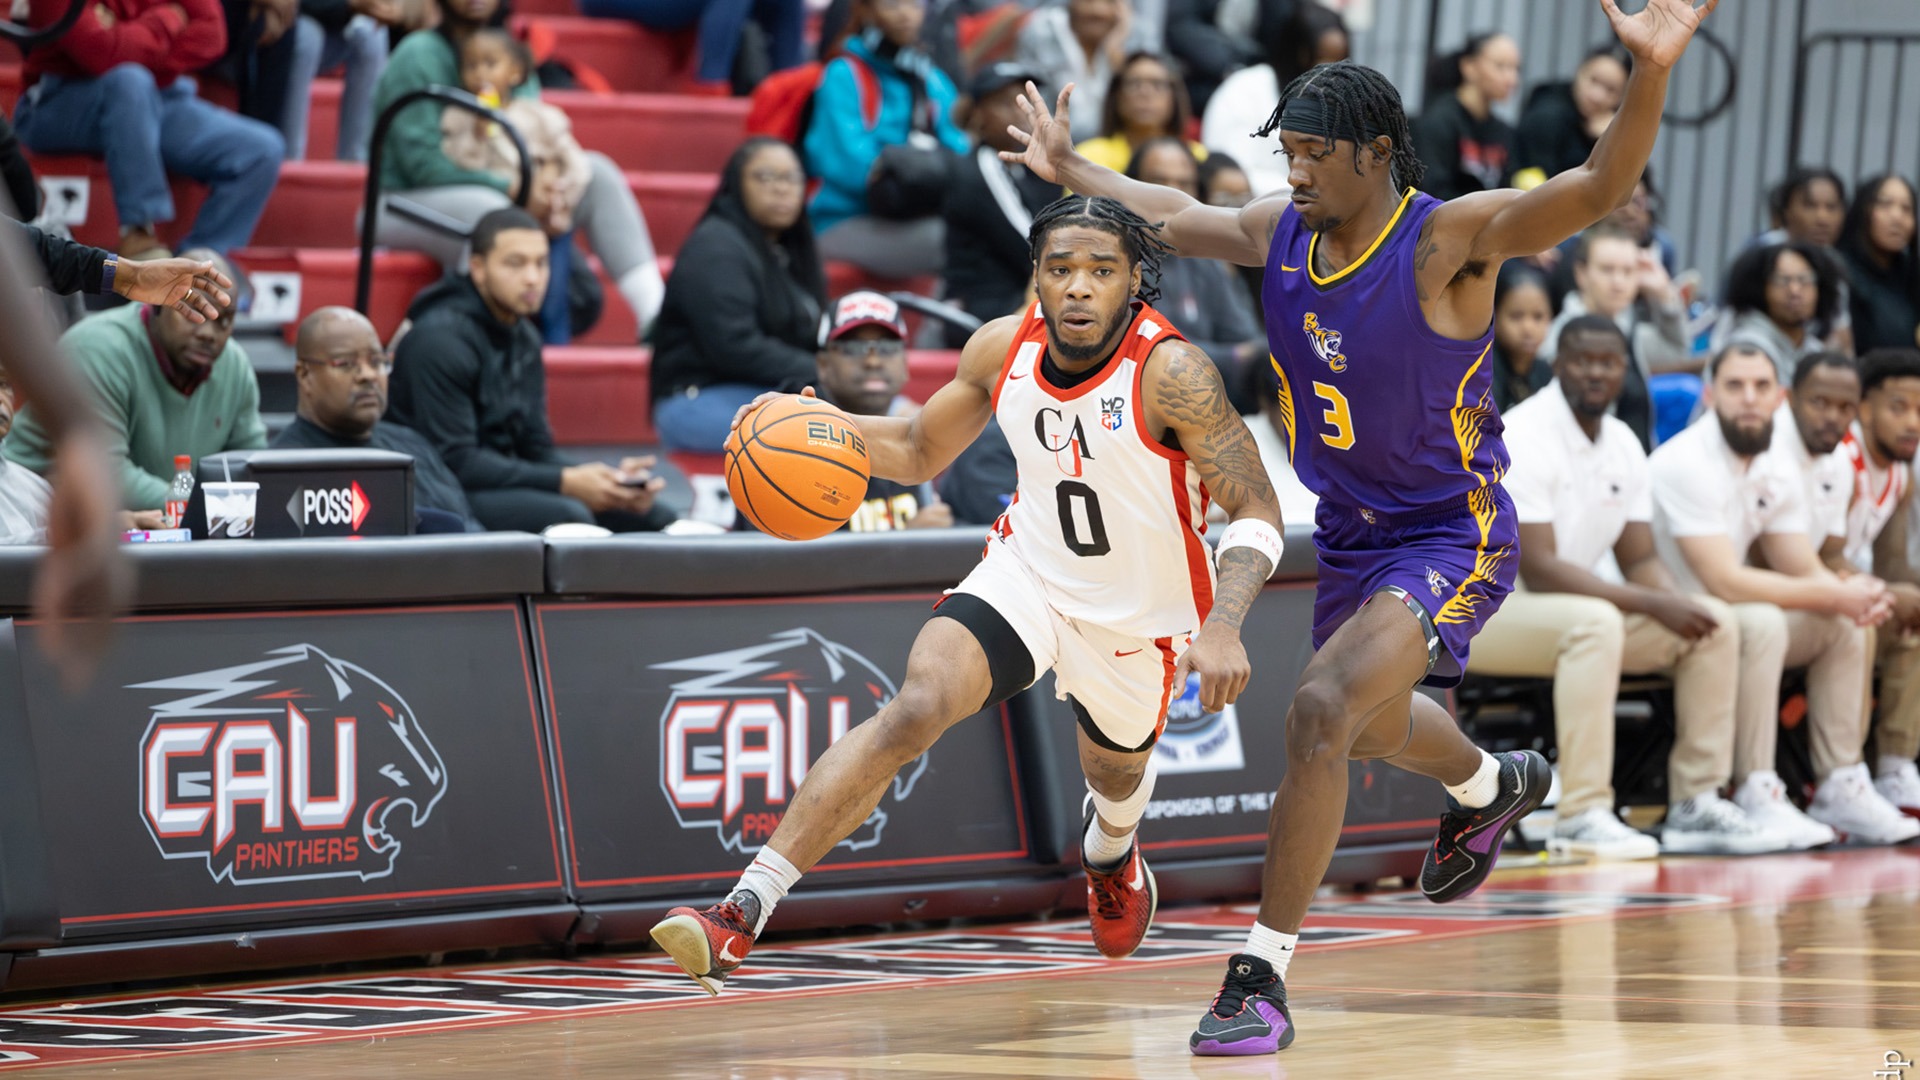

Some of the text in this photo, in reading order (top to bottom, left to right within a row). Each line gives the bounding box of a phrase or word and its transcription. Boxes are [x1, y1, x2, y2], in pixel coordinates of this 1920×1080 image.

[1312, 380, 1356, 451] 3
[807, 421, 867, 458] ELITE
[303, 488, 353, 525] POSS
[1055, 480, 1111, 557] 0
[145, 700, 358, 857] CAU
[1145, 797, 1214, 819] SPONSOR
[1215, 794, 1237, 814] OF
[1239, 793, 1269, 812] THE
[235, 836, 360, 871] PANTHERS
